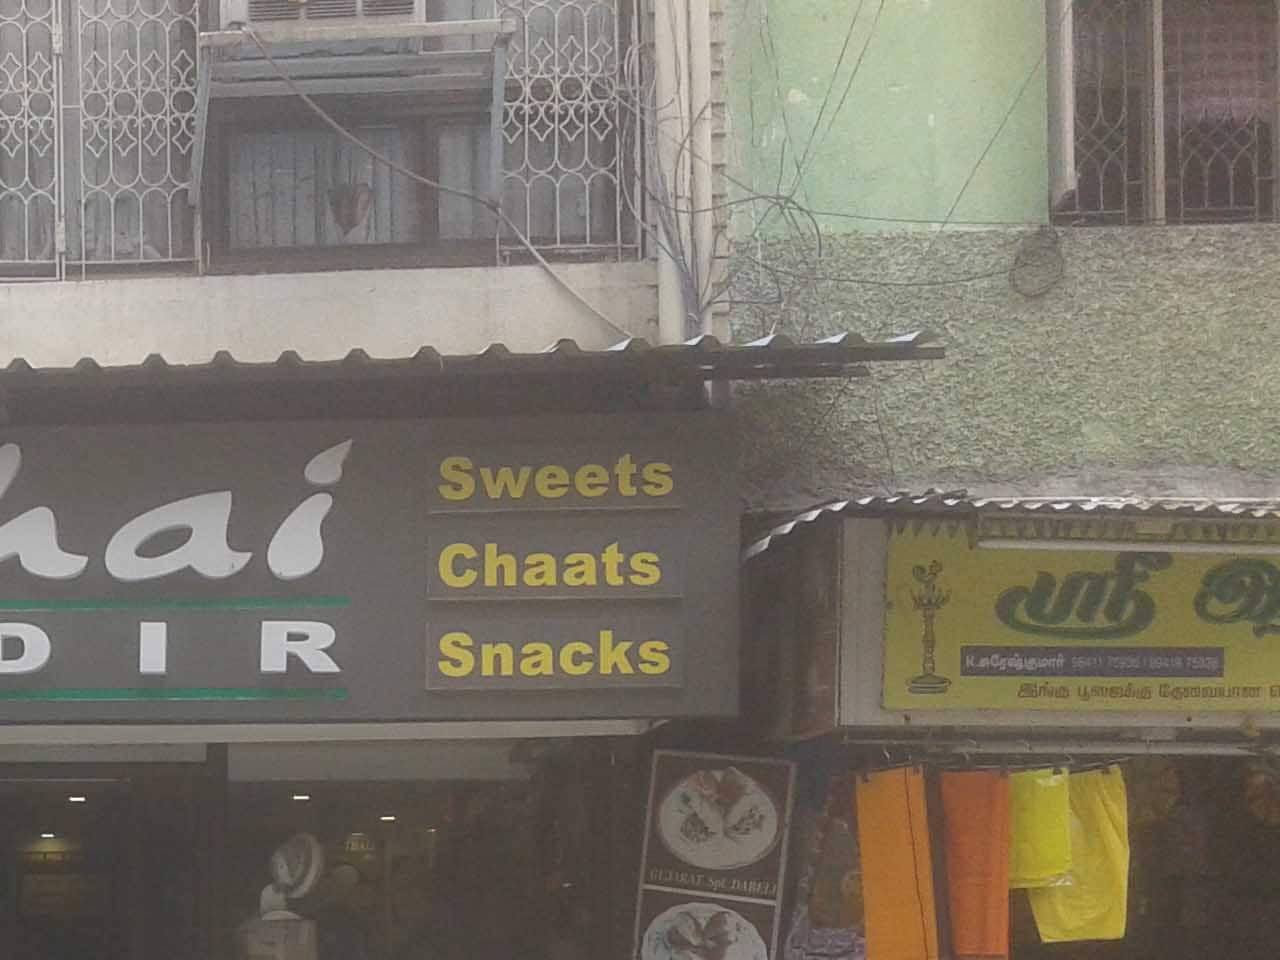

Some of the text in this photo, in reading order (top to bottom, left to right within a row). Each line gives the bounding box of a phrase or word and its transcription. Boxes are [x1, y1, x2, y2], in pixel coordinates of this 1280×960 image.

[438, 454, 674, 500] Sweets
[438, 540, 662, 588] Chaats
[437, 630, 671, 678] Snacks
